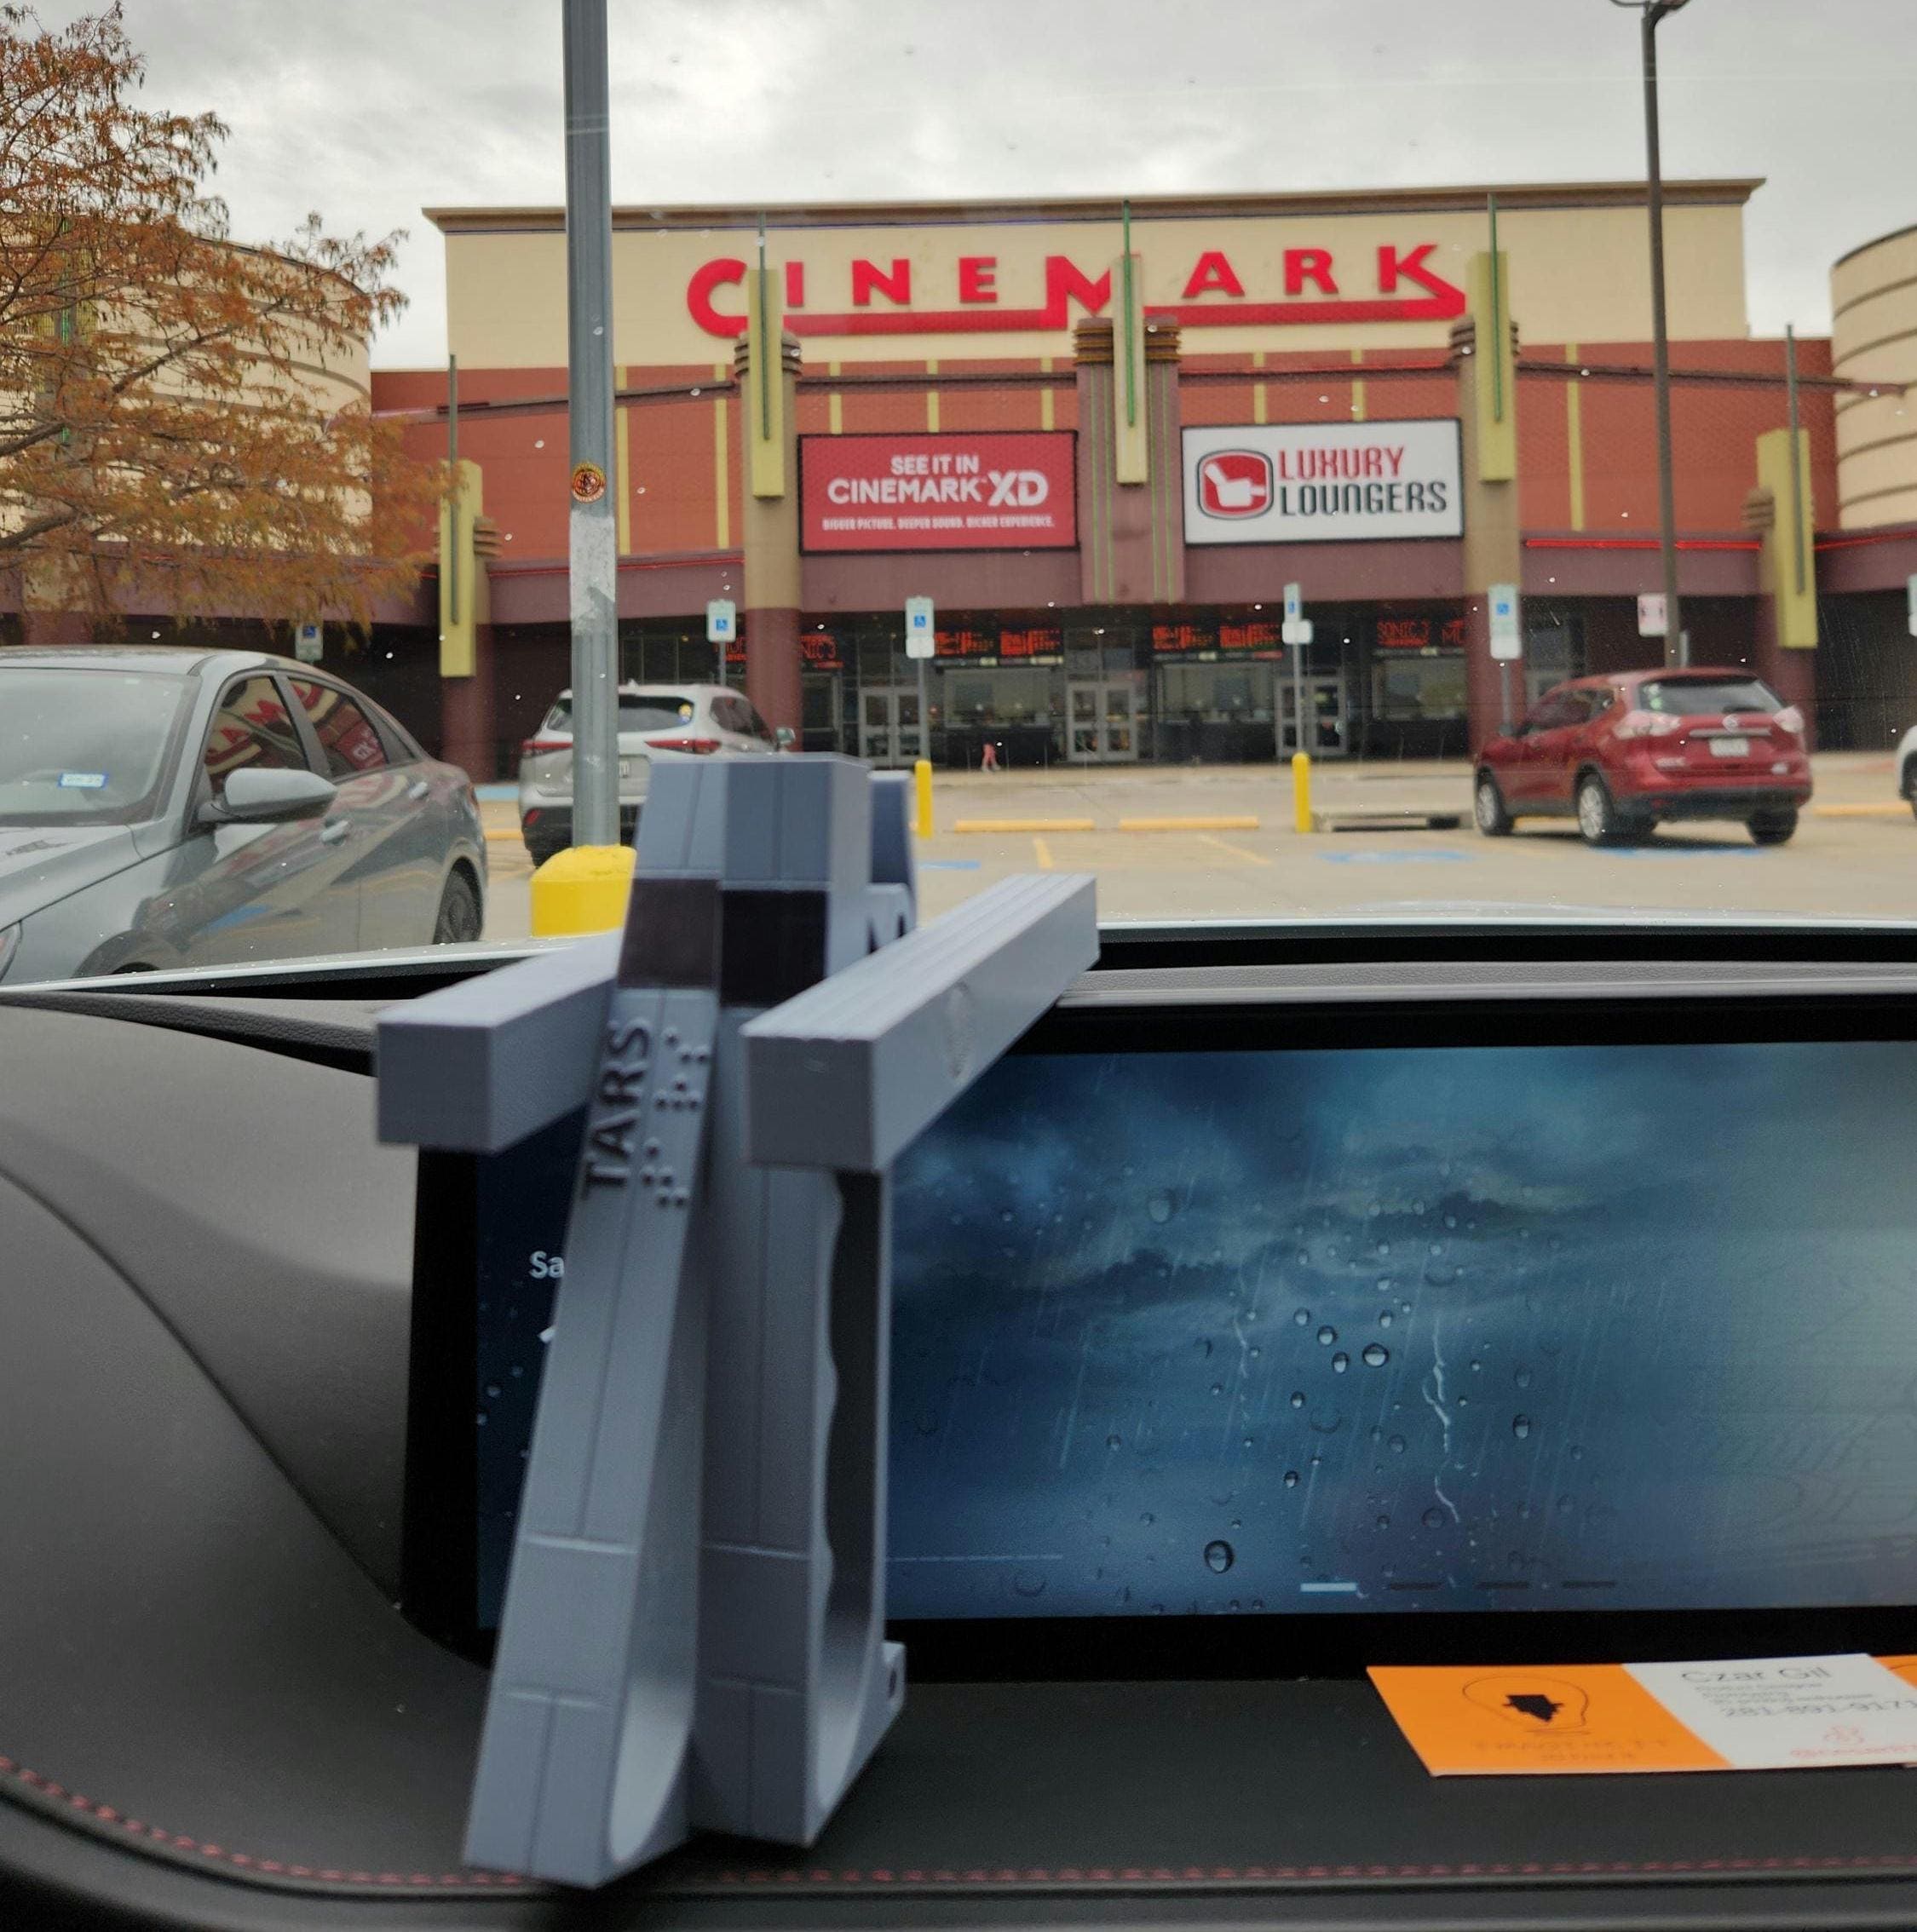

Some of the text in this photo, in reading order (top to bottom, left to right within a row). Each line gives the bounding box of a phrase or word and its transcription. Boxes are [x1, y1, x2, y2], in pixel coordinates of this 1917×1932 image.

[687, 244, 1465, 338] CINEMARK
[890, 454, 979, 474] SEE IT IN
[1279, 446, 1405, 480] LUXURY
[827, 470, 1049, 506] CINEMARK XD
[1280, 480, 1448, 515] LOUNGERS
[584, 1017, 651, 1198] TARS
[1681, 1670, 1764, 1683] Czar
